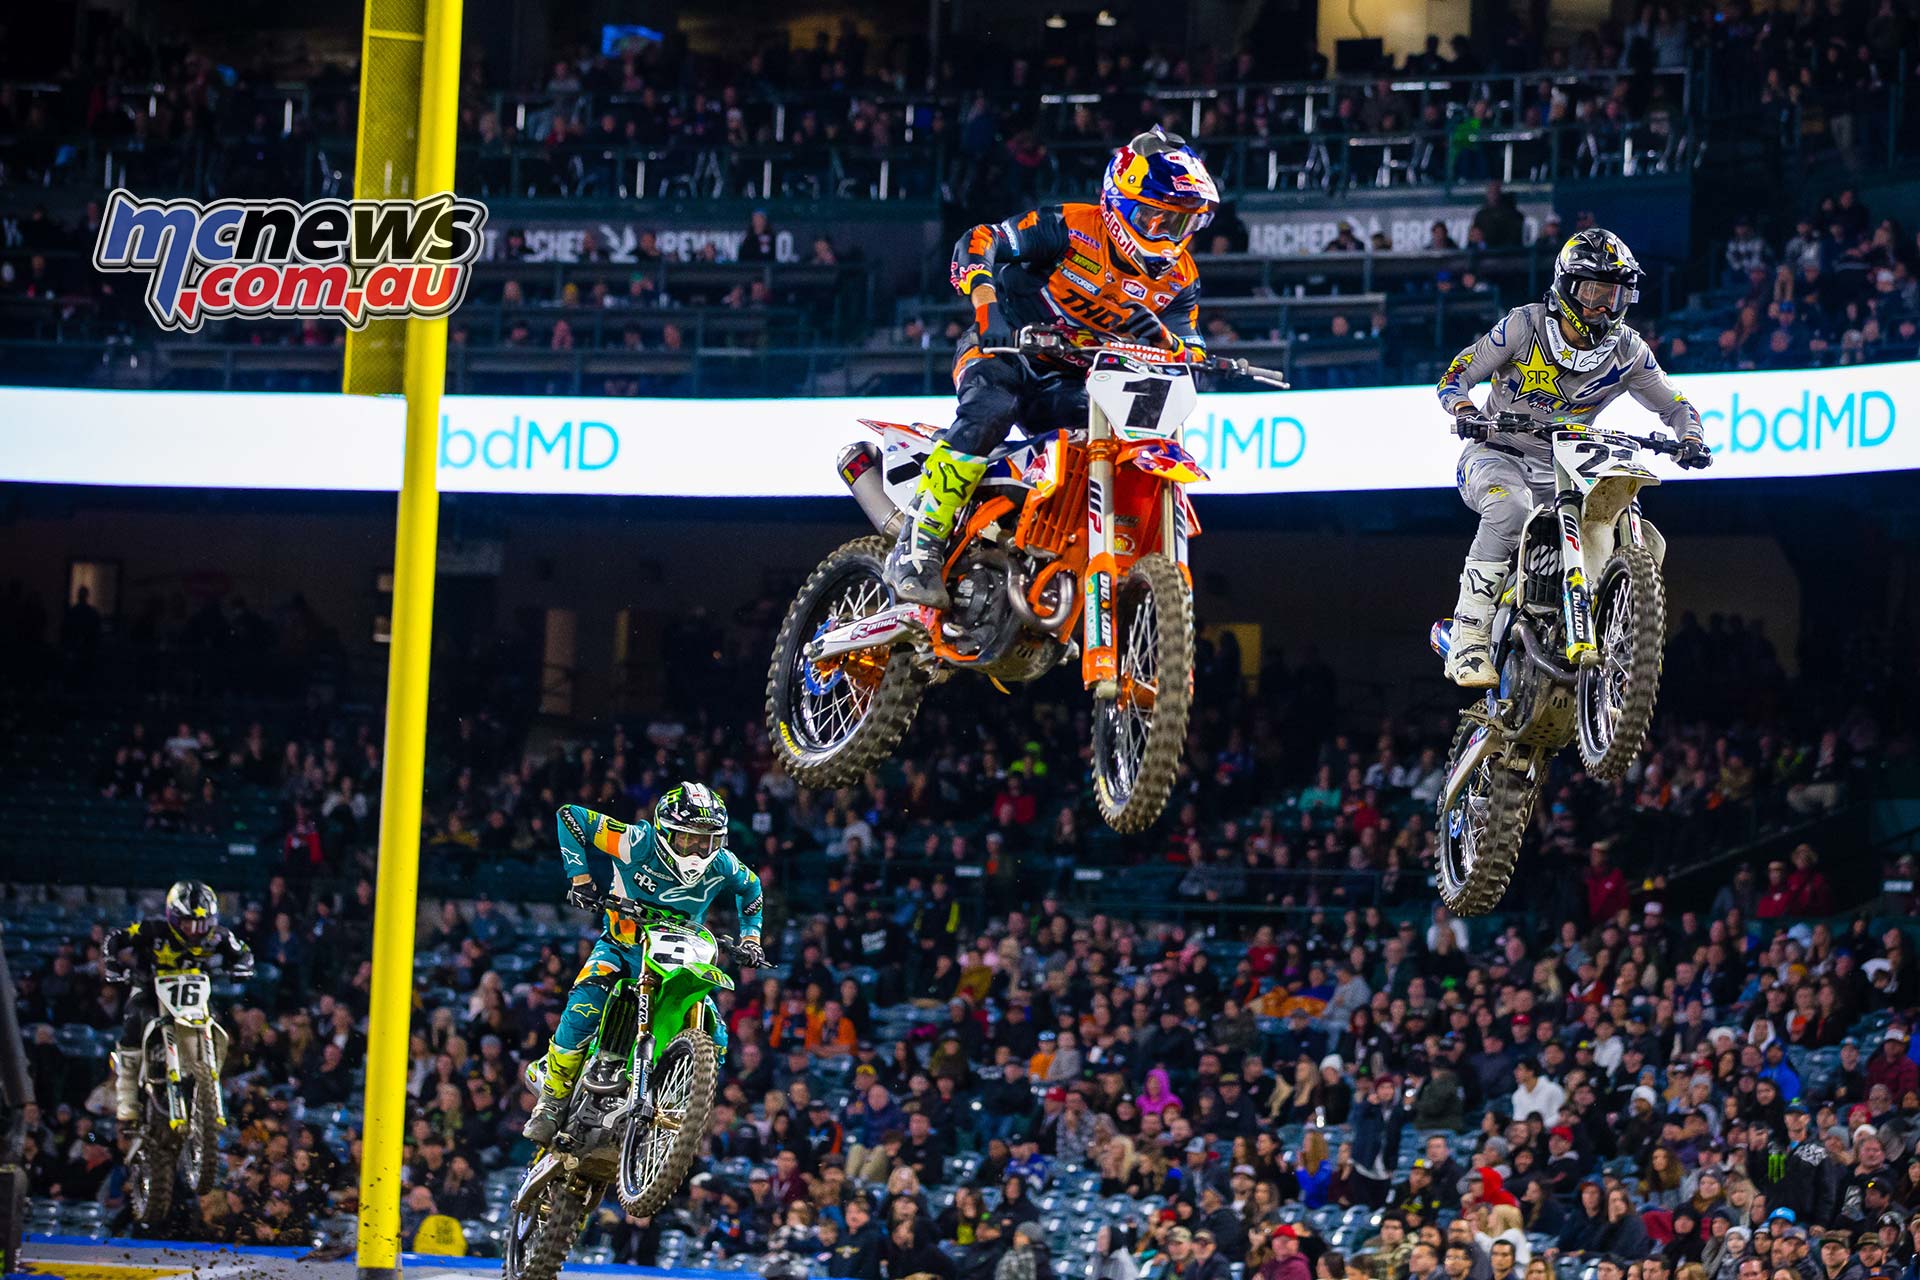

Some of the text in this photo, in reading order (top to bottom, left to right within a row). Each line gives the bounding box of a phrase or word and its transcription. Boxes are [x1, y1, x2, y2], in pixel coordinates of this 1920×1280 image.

[1109, 221, 1137, 258] Bull
[1061, 268, 1099, 295] MOTOREX
[1060, 288, 1124, 329] THO
[1122, 377, 1173, 430] 1
[1701, 389, 1896, 454] cbdMD
[439, 414, 620, 471] bdMD
[1184, 411, 1306, 470] dMD
[1100, 573, 1112, 647] DULOP
[1572, 591, 1585, 640] DUNLOP
[633, 871, 657, 894] PPG
[168, 983, 200, 1008] 16
